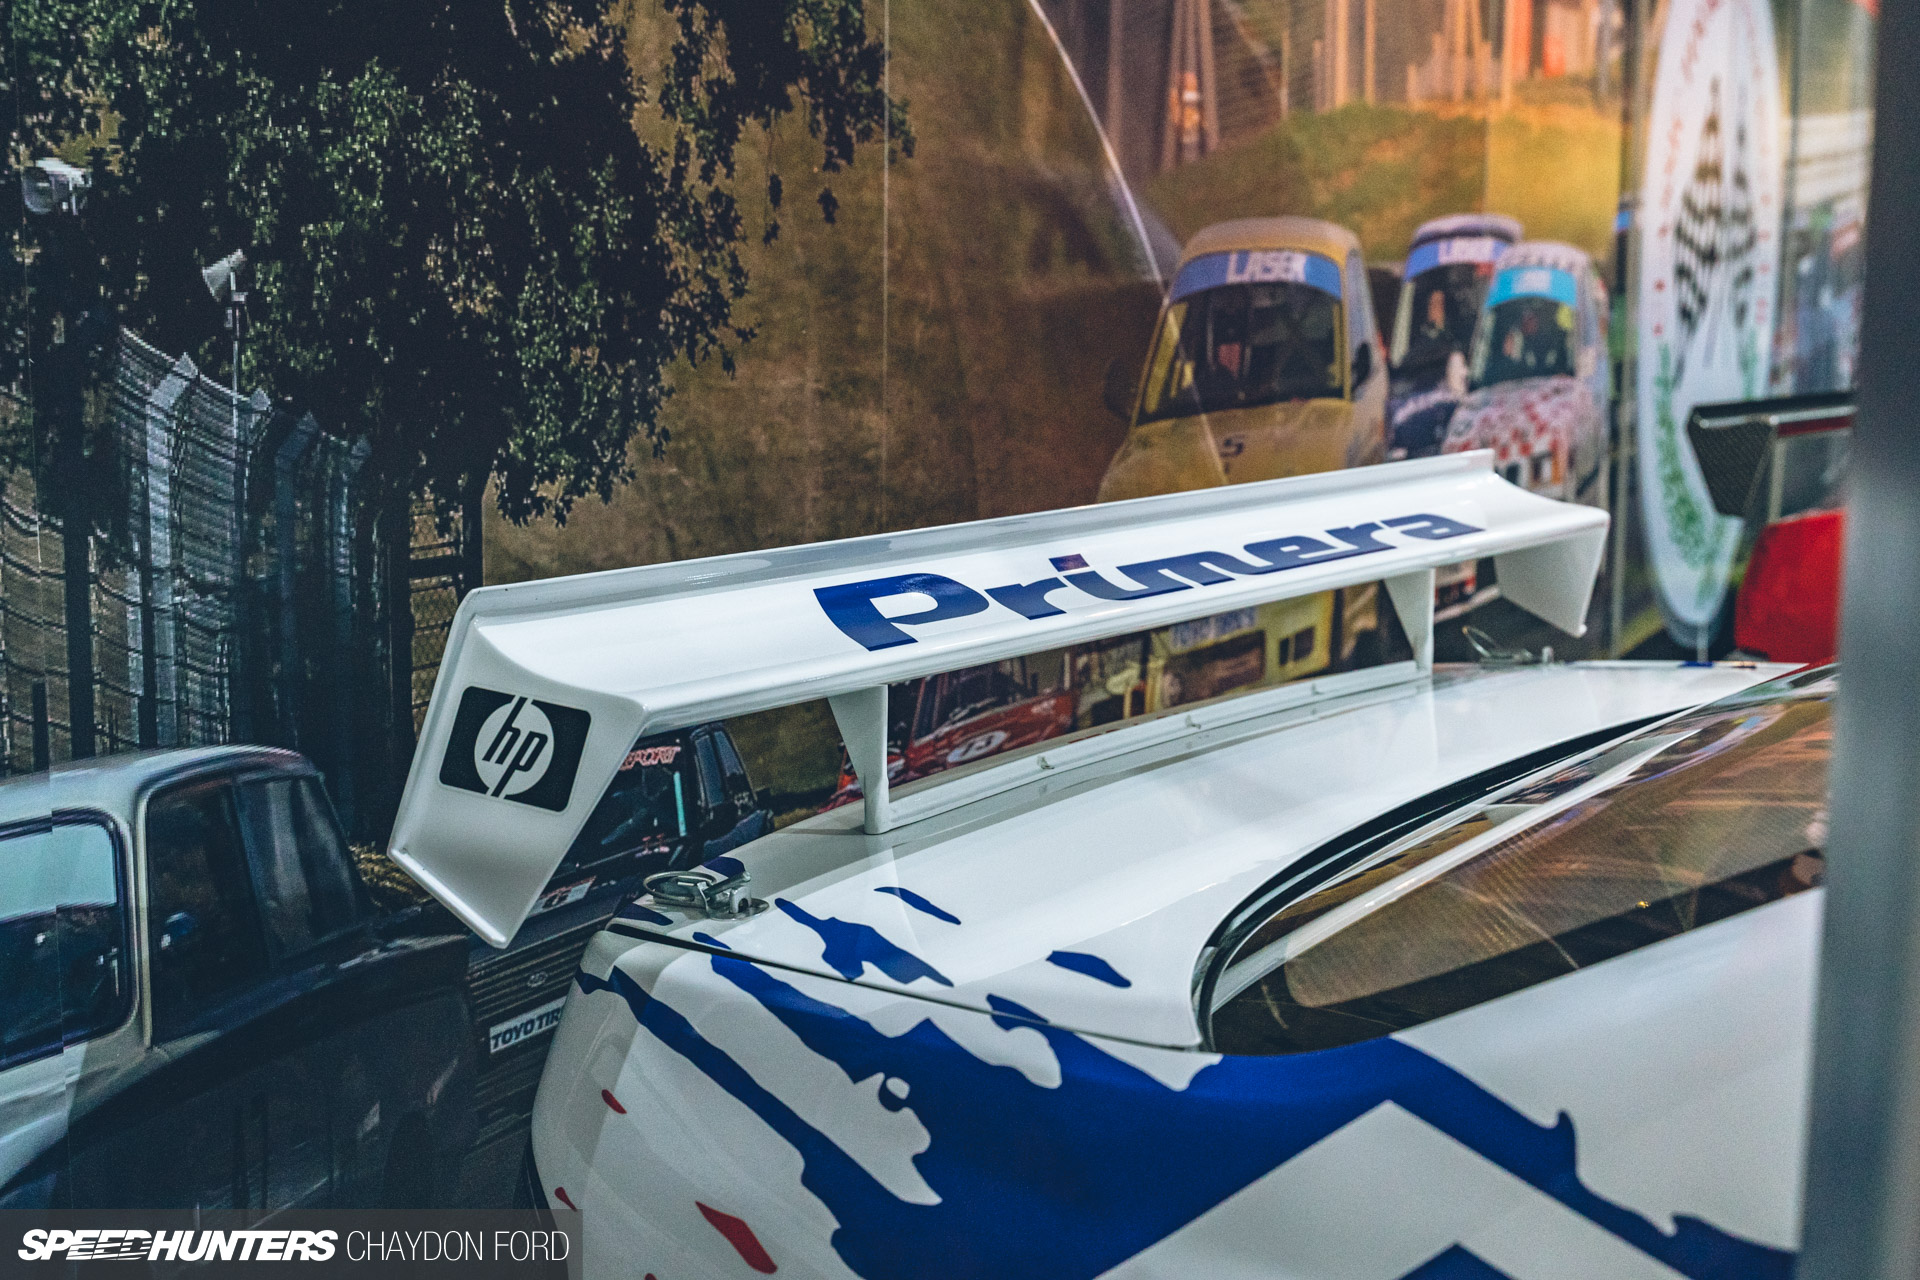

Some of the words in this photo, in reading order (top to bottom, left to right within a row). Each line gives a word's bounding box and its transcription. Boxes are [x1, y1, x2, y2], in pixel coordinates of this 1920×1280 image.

[812, 512, 1484, 652] Primera
[482, 696, 548, 798] hp
[491, 1019, 536, 1049] TOYO
